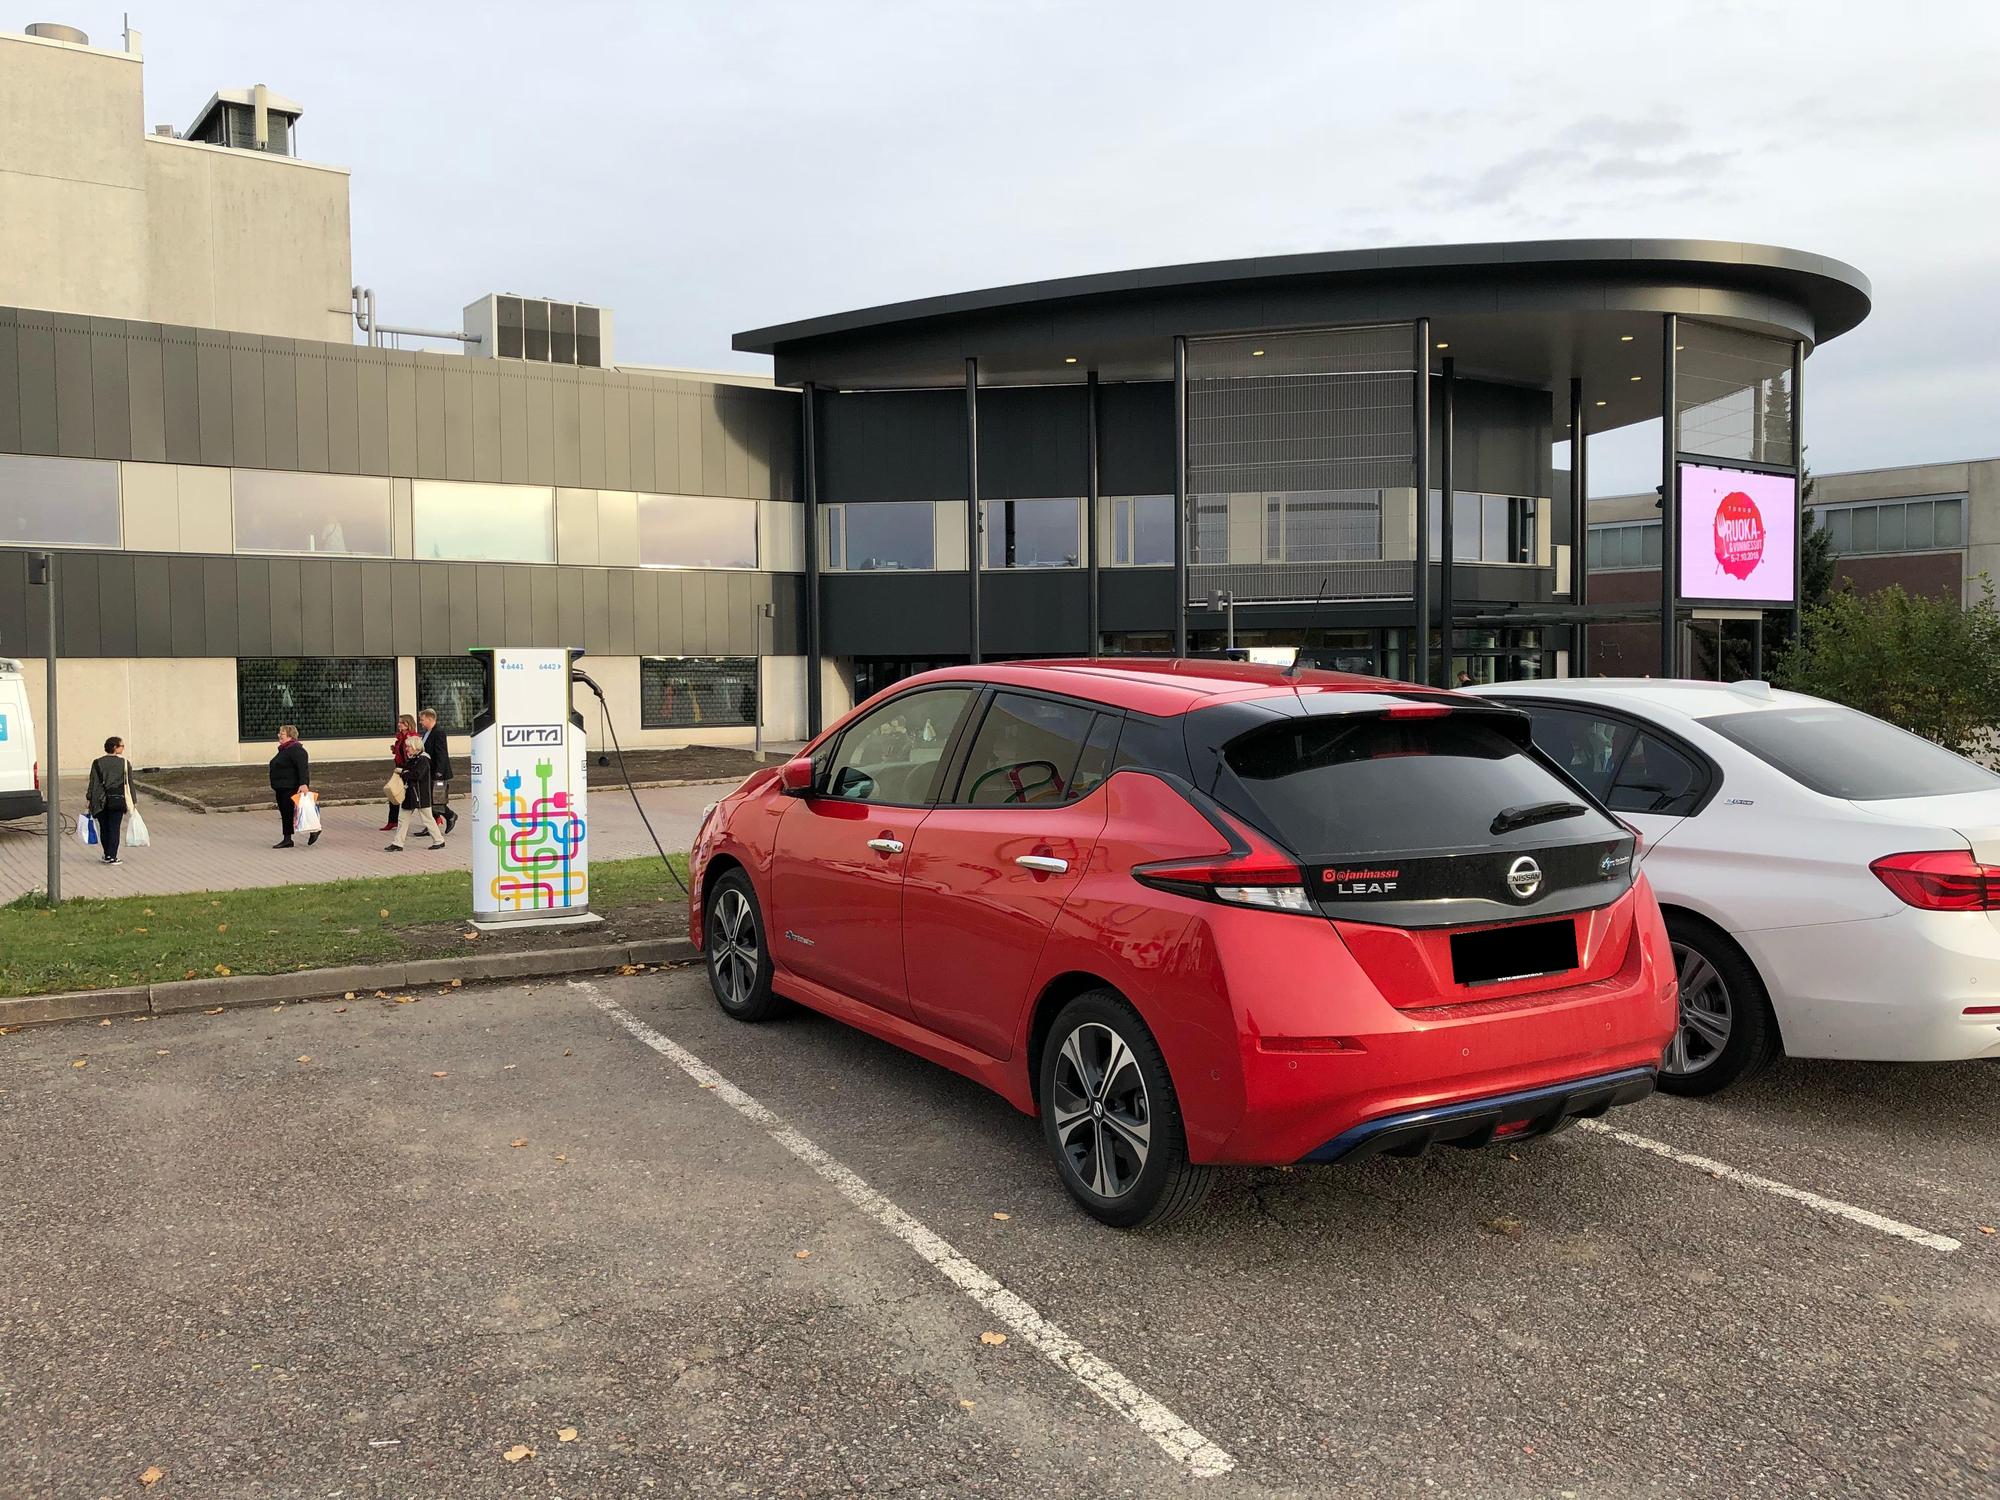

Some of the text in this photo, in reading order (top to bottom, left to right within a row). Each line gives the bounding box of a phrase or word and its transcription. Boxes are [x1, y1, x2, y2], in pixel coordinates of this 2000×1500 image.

[1726, 517, 1761, 542] RUOKA-
[1337, 868, 1399, 881] @janinassu
[1512, 873, 1540, 882] NISSAN
[1338, 882, 1397, 894] LEAF
